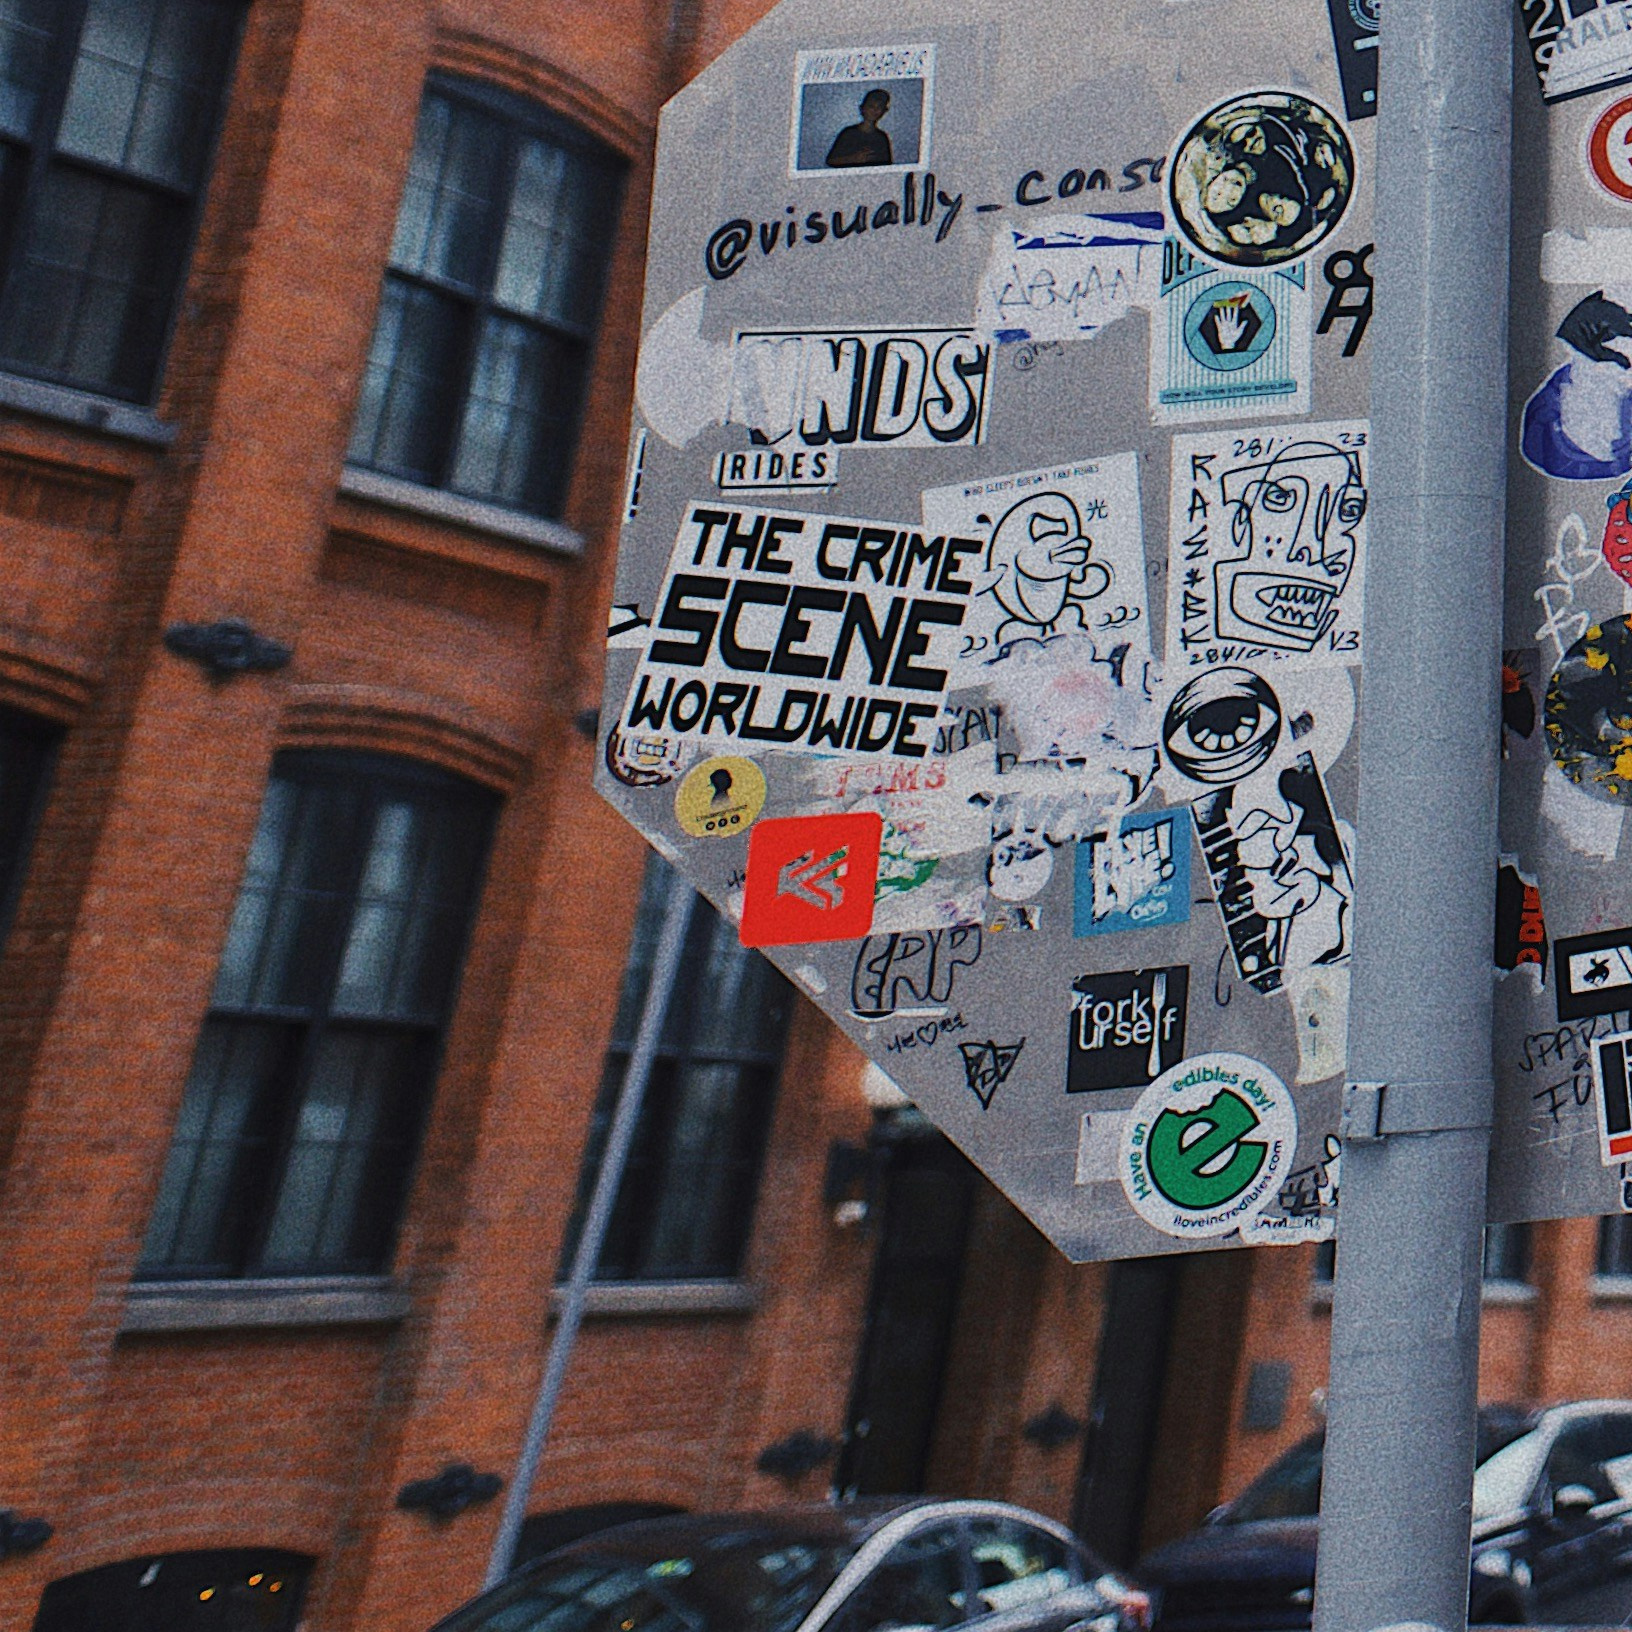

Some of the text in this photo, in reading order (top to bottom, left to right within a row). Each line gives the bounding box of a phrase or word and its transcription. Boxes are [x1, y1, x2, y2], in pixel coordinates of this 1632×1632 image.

[730, 451, 829, 481] RIDES
[691, 508, 984, 595] THE CRIME
[648, 573, 967, 692] SCENE
[627, 674, 939, 758] WORLDWIDE
[1078, 988, 1151, 1023] fork
[1129, 1066, 1277, 1201] Have an edibles day!
[1172, 1138, 1284, 1228] iloveincredibles.com
